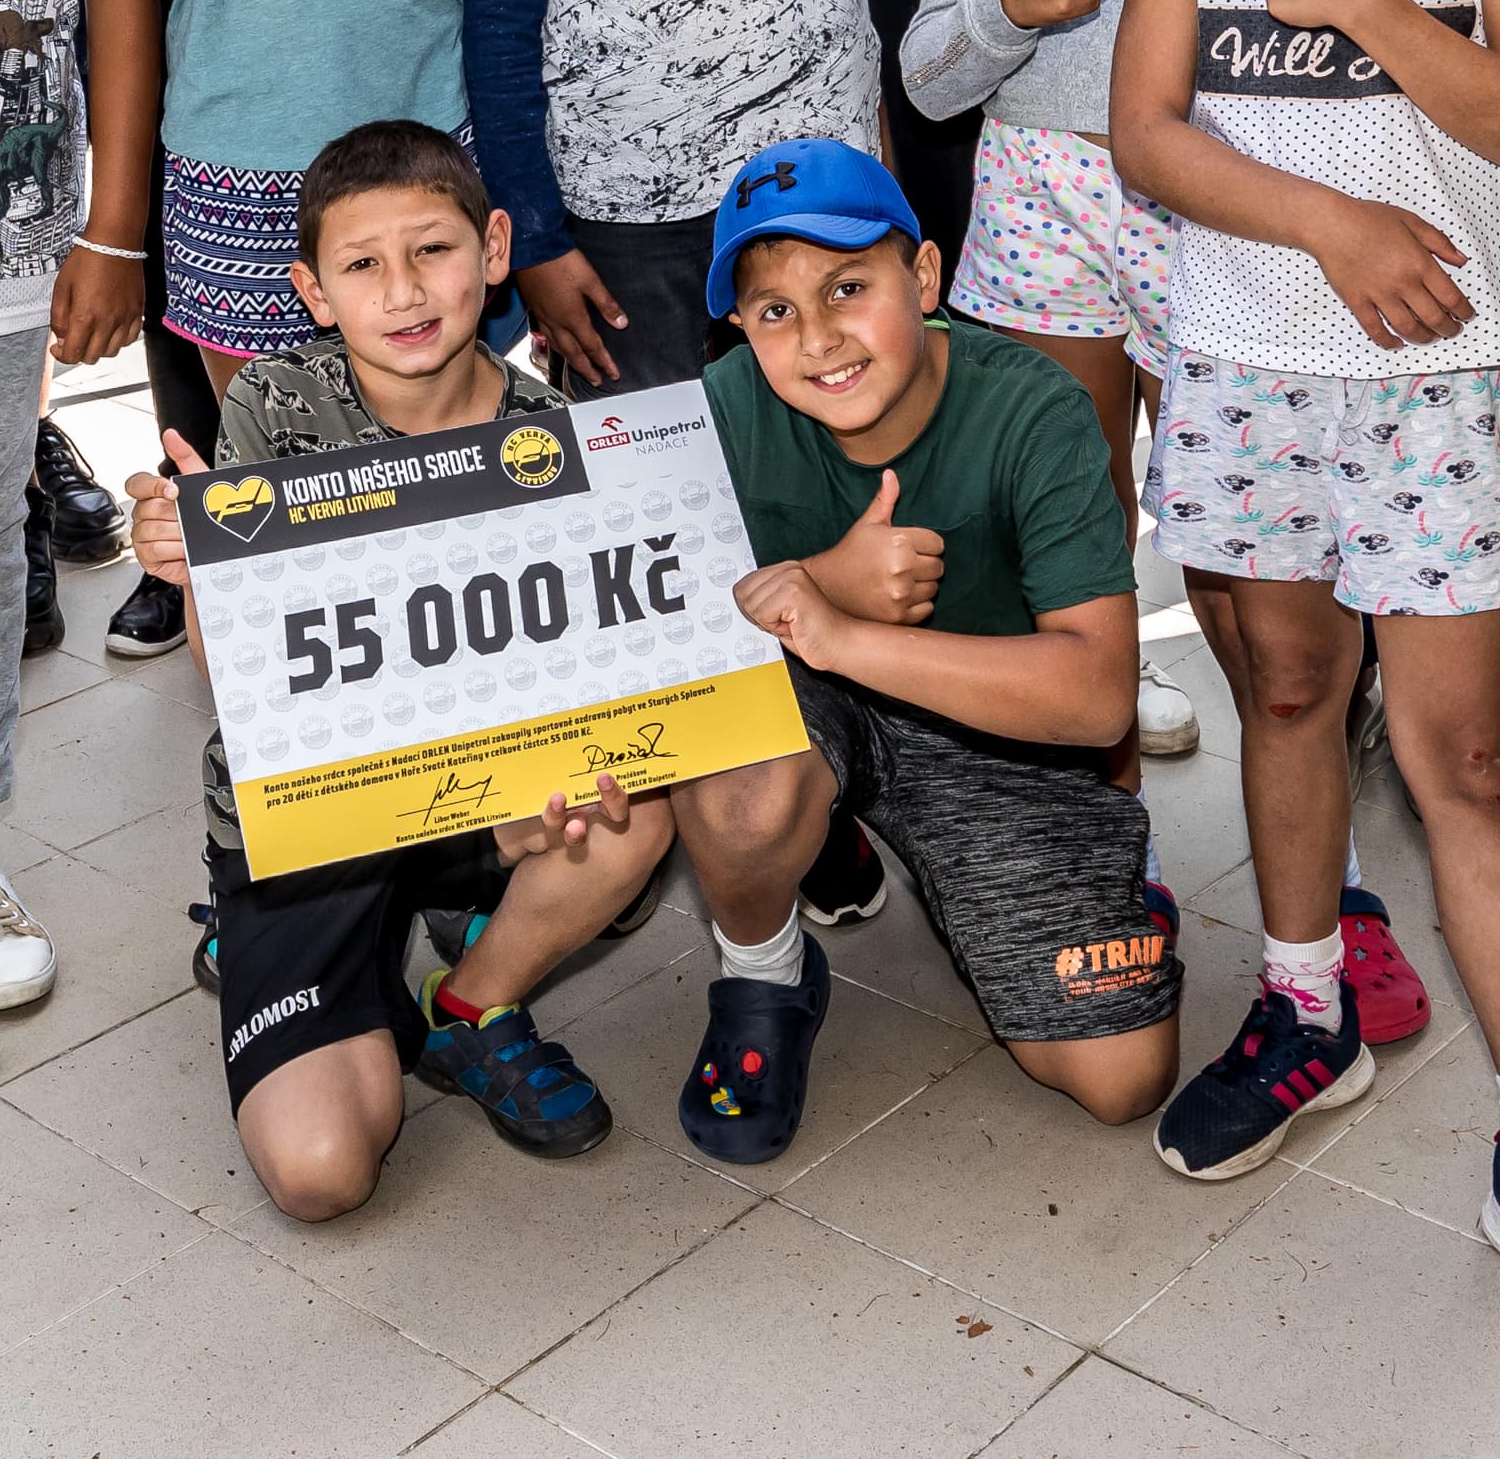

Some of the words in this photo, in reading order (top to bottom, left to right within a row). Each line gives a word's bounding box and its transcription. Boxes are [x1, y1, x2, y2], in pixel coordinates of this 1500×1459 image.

[1210, 27, 1335, 78] Will
[519, 430, 552, 444] VERVA
[589, 434, 629, 450] ORLEN
[631, 415, 707, 442] Unipetrol
[635, 436, 690, 456] NADACE
[282, 473, 345, 506] KONTO
[351, 456, 423, 494] NAŠEHO
[425, 445, 486, 480] SRDCE
[289, 505, 306, 524] HC
[308, 498, 345, 521] VERVA
[347, 489, 397, 515] LITVÍNOV
[284, 597, 384, 695] 55
[406, 560, 569, 668] 000
[589, 532, 687, 629] Kč
[264, 781, 289, 794] Konto
[292, 774, 321, 788] našeho
[323, 769, 345, 782] srdce
[347, 759, 383, 777] společně
[392, 751, 420, 766] Nadací
[422, 745, 449, 759] ORLEN
[451, 736, 490, 753] Unipetrol
[492, 727, 531, 744] zakoupily
[533, 717, 573, 735] sportovně
[575, 707, 611, 725] ozdravný
[613, 703, 636, 718] pobyt
[637, 702, 647, 710] ve
[648, 693, 679, 708] Starých
[680, 684, 715, 701] Splavech
[267, 798, 280, 809] pro
[283, 793, 293, 804] 20
[296, 788, 312, 801] dětí
[320, 781, 359, 796] dětského
[361, 774, 394, 787] domova
[401, 764, 421, 778] Hoře
[422, 761, 445, 773] Svaté
[447, 752, 483, 767] Kateřiny
[491, 743, 521, 757] celkové
[523, 737, 548, 750] částce
[550, 733, 561, 744] 55
[562, 729, 579, 741] 000
[581, 726, 593, 737] Kč.
[627, 778, 647, 789] ORLEN
[451, 810, 470, 820] Weber
